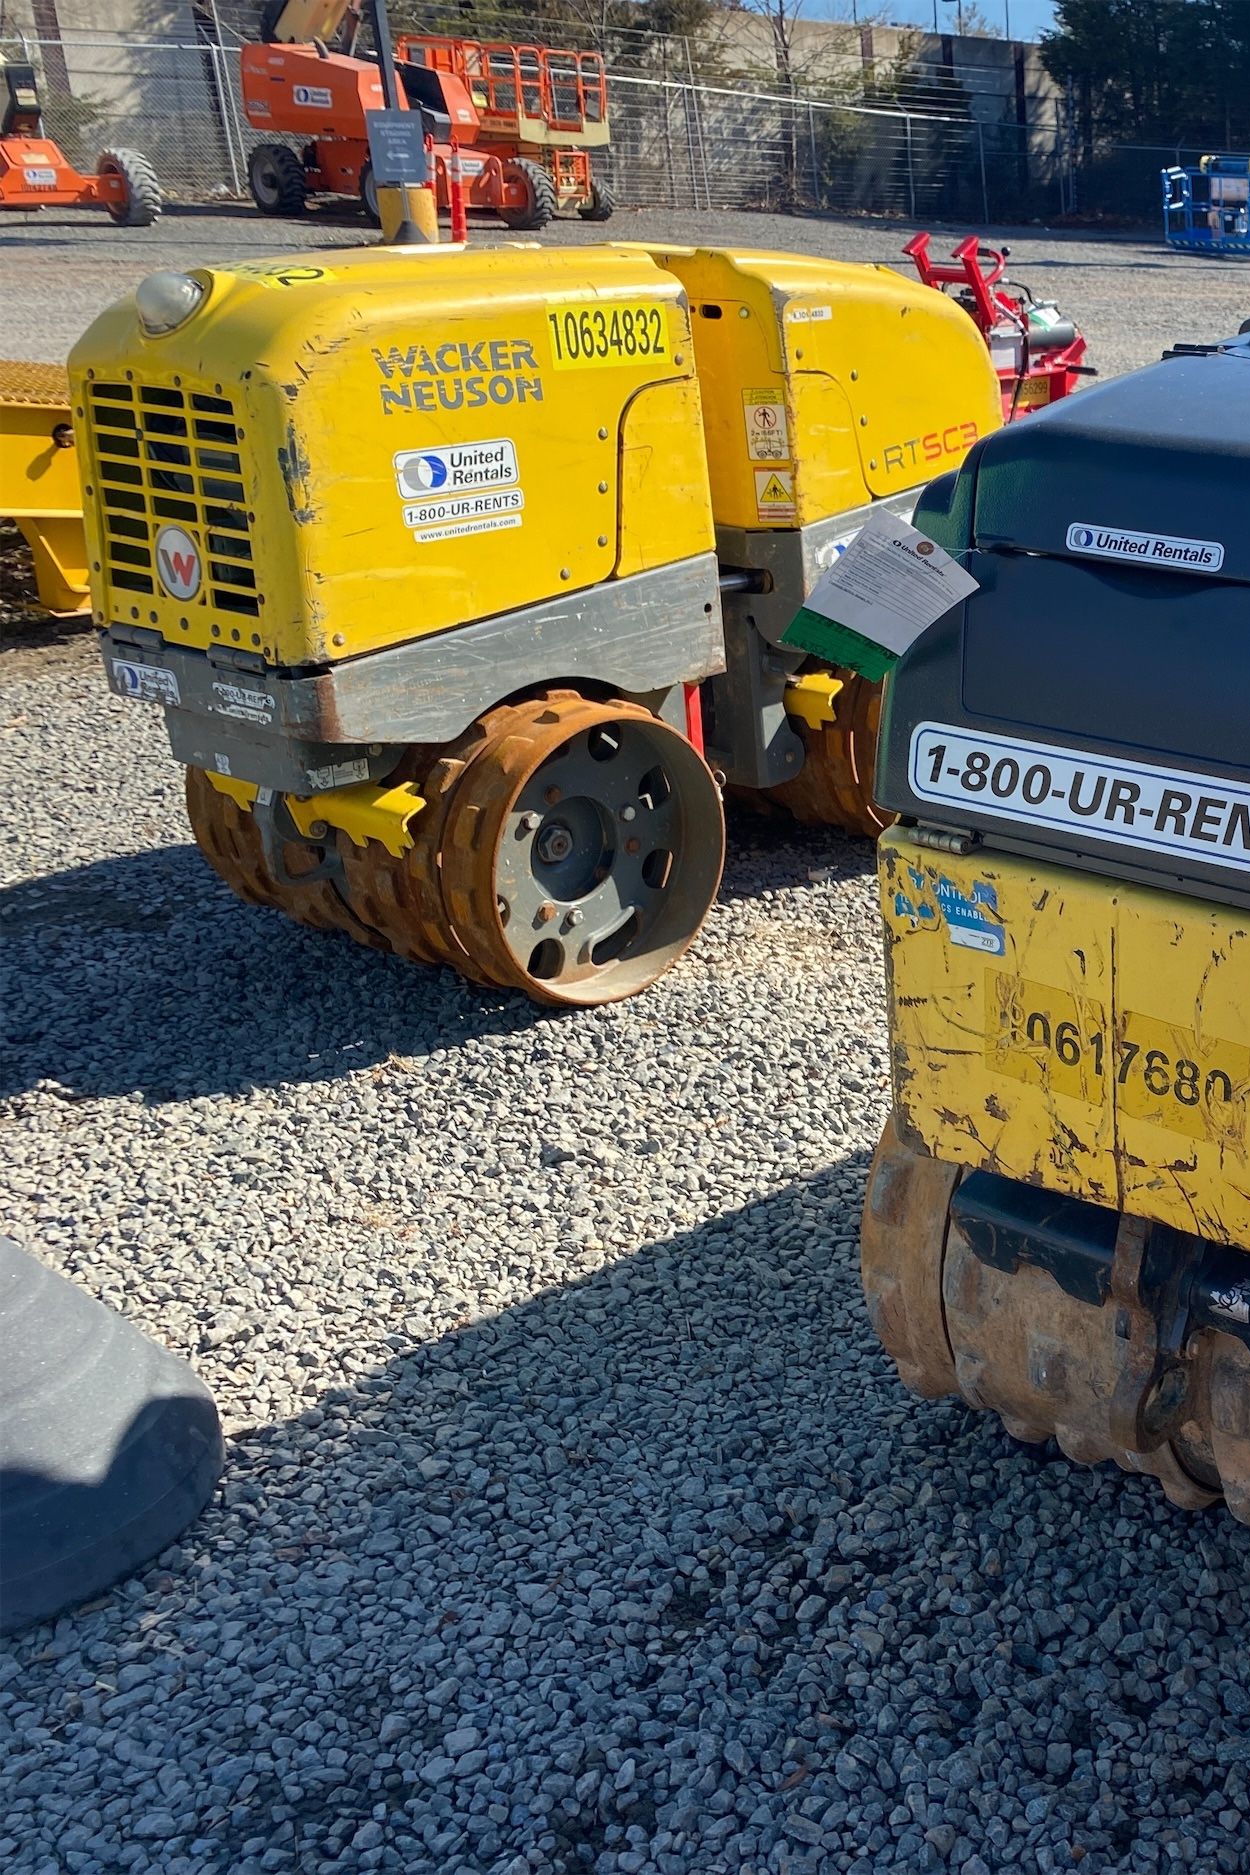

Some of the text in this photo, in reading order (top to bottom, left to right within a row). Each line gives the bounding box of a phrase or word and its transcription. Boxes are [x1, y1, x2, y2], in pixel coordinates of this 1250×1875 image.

[549, 308, 665, 361] 10634832
[371, 339, 540, 379] WACKER
[381, 374, 544, 415] NEUSON
[450, 446, 505, 468] United
[453, 464, 512, 486] Rentals
[407, 493, 520, 523] 1-800-UR-RENTS
[420, 517, 516, 541] www.unitedrentals.com
[901, 545, 923, 560] United
[1096, 533, 1213, 564] United Rentals
[1018, 1012, 1232, 1106] 0617680
